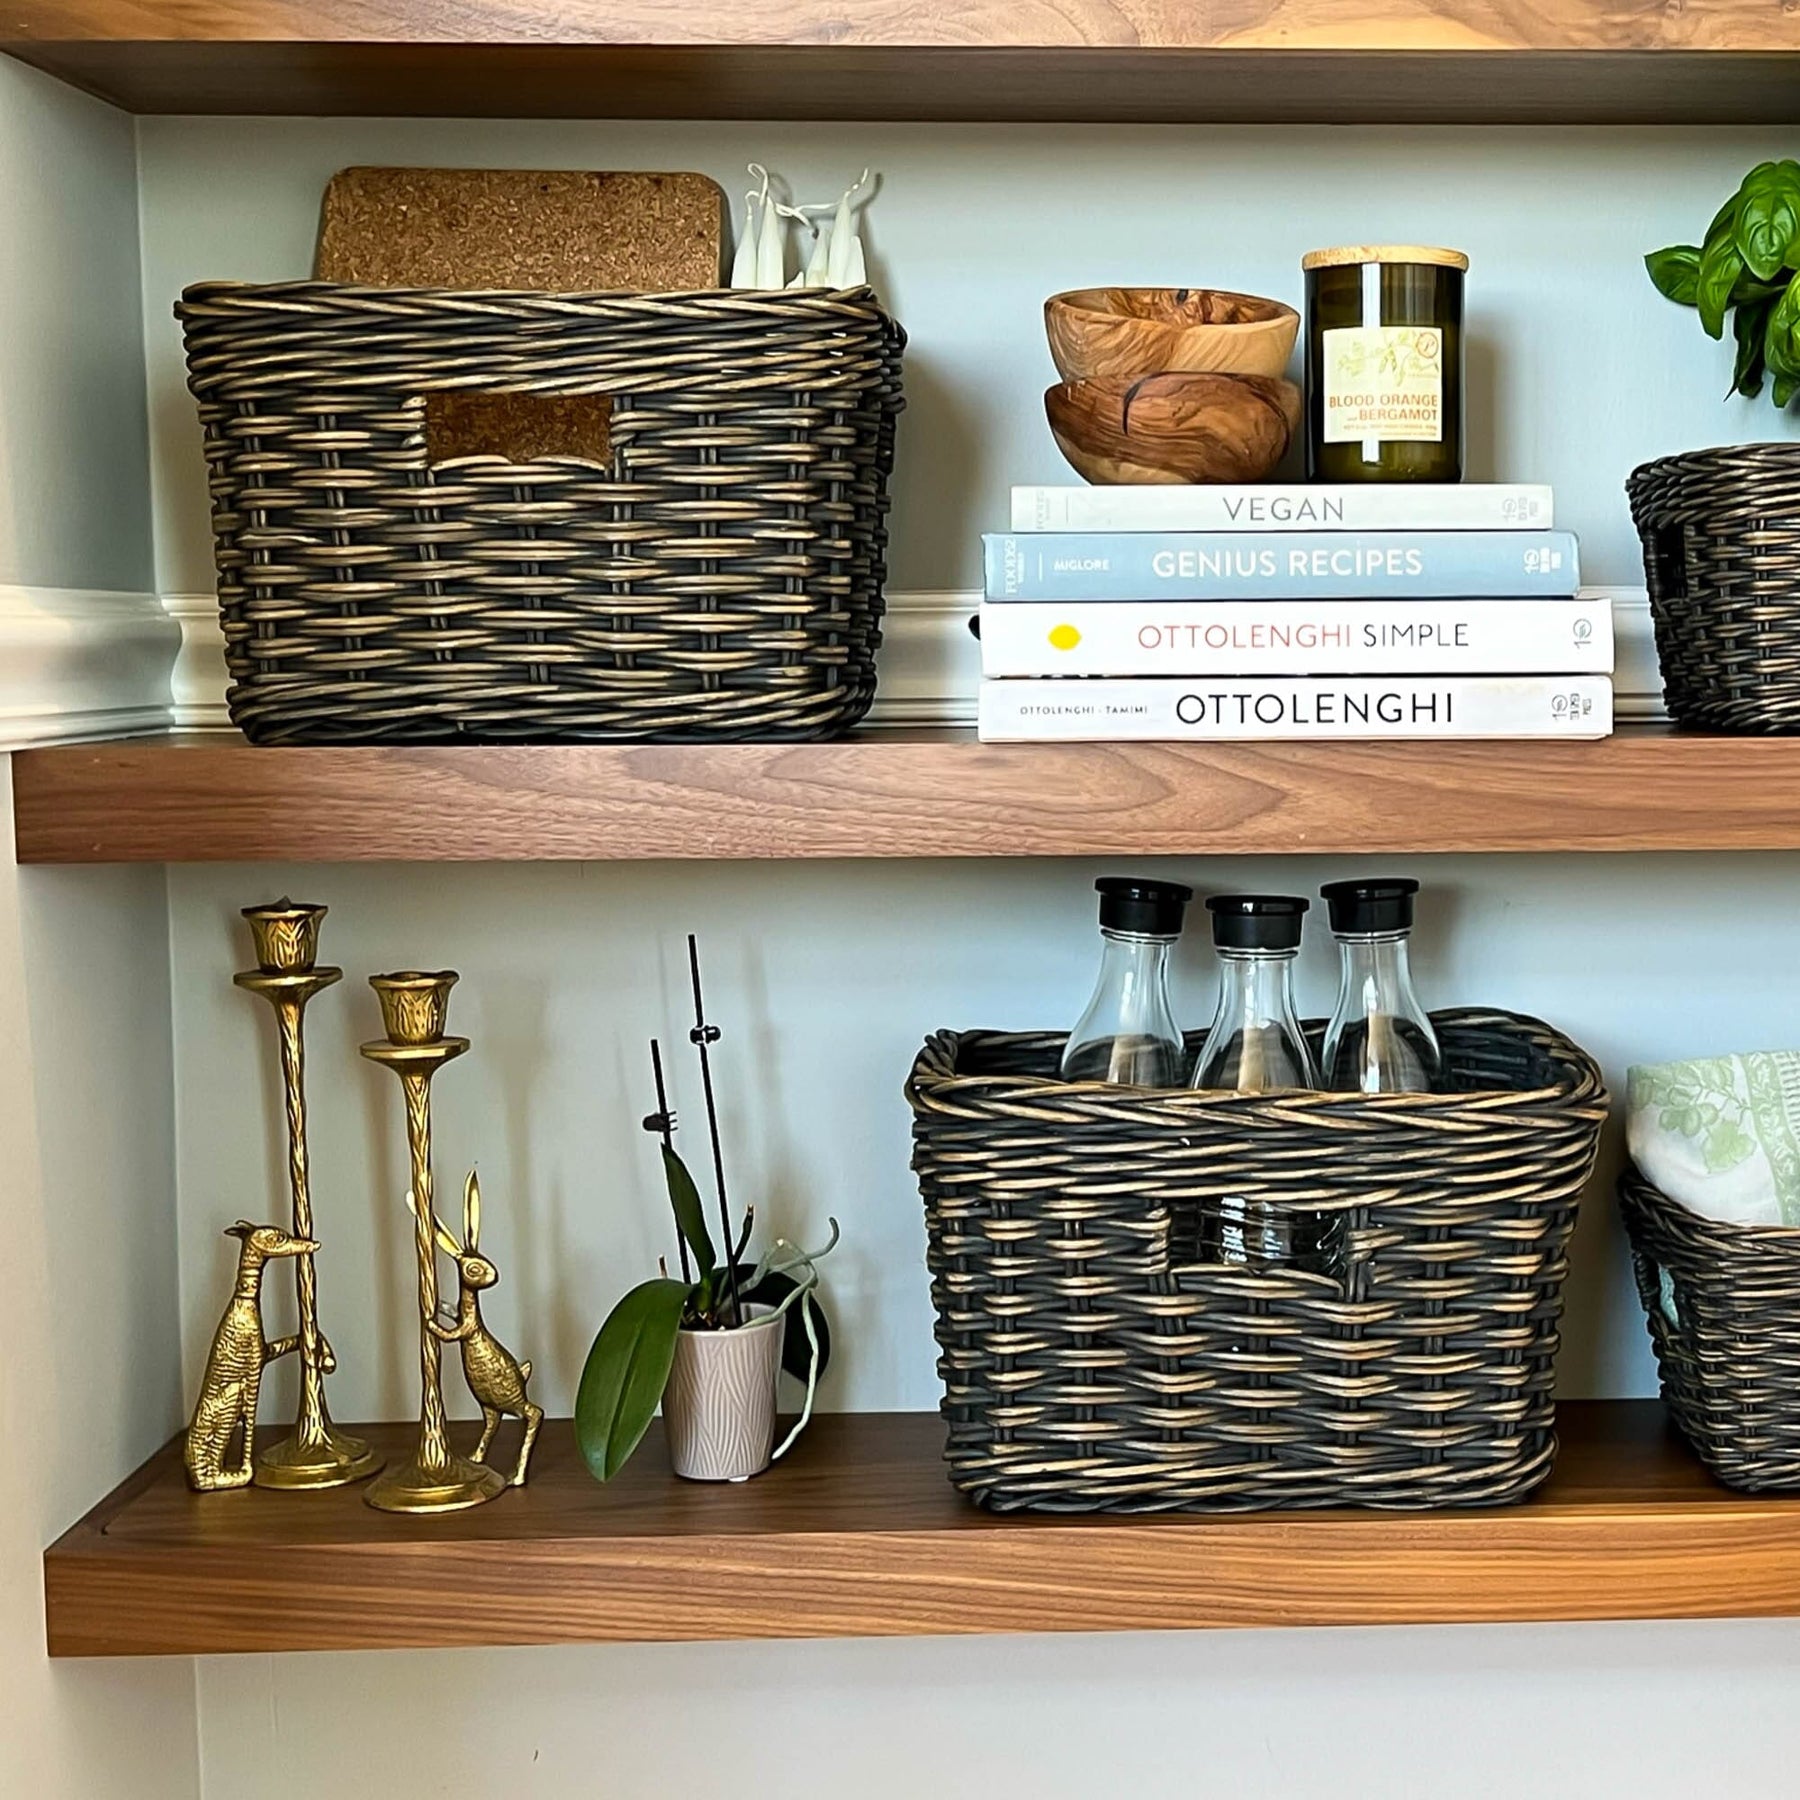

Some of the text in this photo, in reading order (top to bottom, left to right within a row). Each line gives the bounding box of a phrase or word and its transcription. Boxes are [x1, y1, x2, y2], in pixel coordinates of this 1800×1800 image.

[1329, 394, 1438, 408] BLOOD ORANGE
[1359, 408, 1437, 421] BERGAMOT
[1222, 497, 1343, 521] VEGAN
[1152, 549, 1423, 578] GENIUS RECIPES
[1138, 623, 1469, 648] OTTOLENGHI SIMPLE
[1020, 705, 1148, 715] OTTOLENGHI TAMIMI
[1176, 693, 1452, 724] OTTOLENGHI
